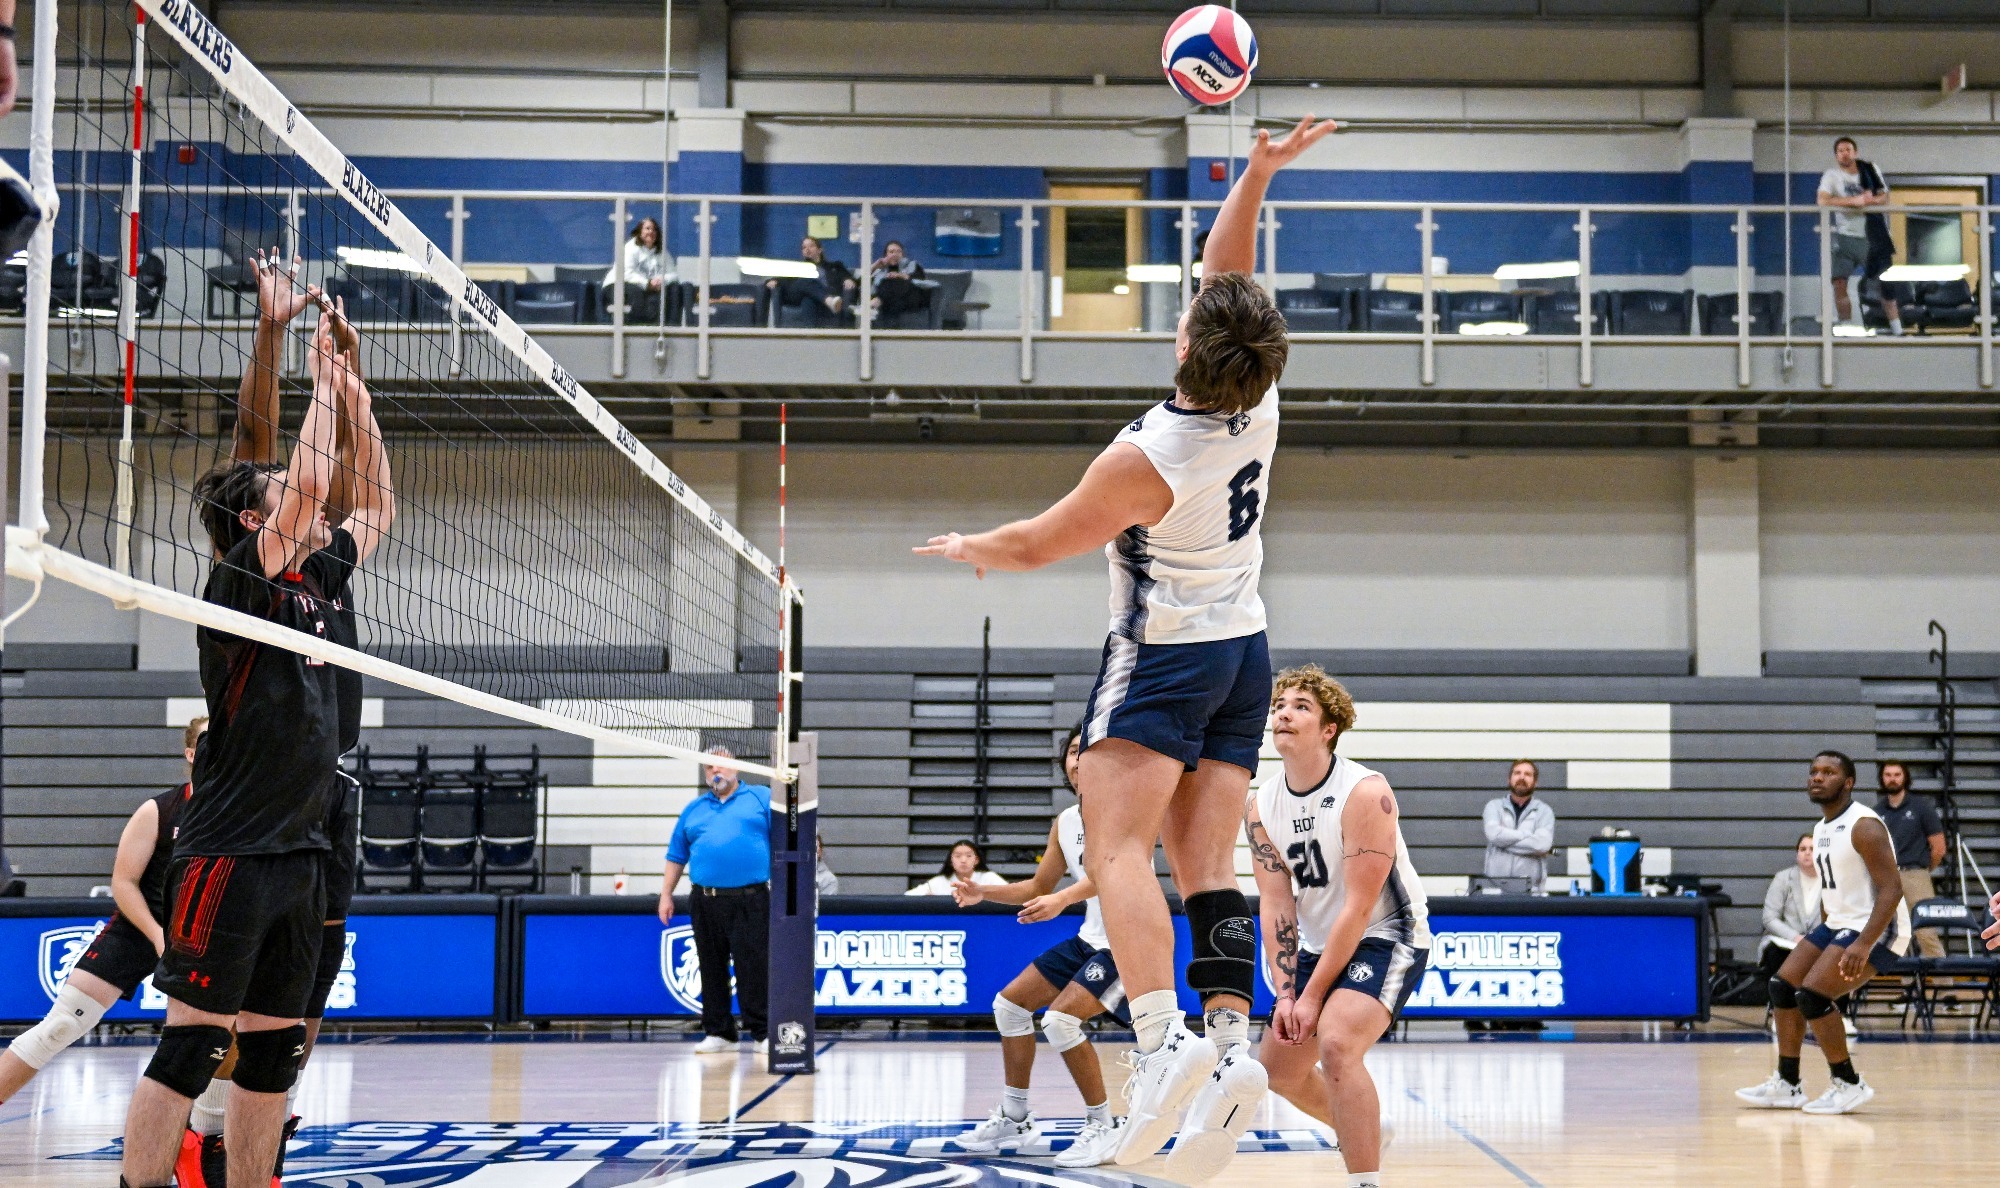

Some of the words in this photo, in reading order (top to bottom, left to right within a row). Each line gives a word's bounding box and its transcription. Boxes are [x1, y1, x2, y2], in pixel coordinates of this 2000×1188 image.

[1192, 64, 1223, 92] NCAA
[1208, 51, 1235, 77] molten
[342, 158, 391, 226] BLAZERS
[463, 276, 499, 328] BLAZERS
[551, 360, 578, 400] BLAZERS
[1227, 458, 1263, 542] 6
[1287, 839, 1329, 888] 20
[1816, 853, 1836, 889] 11
[839, 931, 966, 968] COLLEGE
[1436, 932, 1561, 969] COLLEGE
[815, 969, 967, 1006] AZERS
[1404, 970, 1563, 1007] AZERS
[1157, 1066, 1168, 1085] FLOW
[285, 1139, 845, 1161] COLLE
